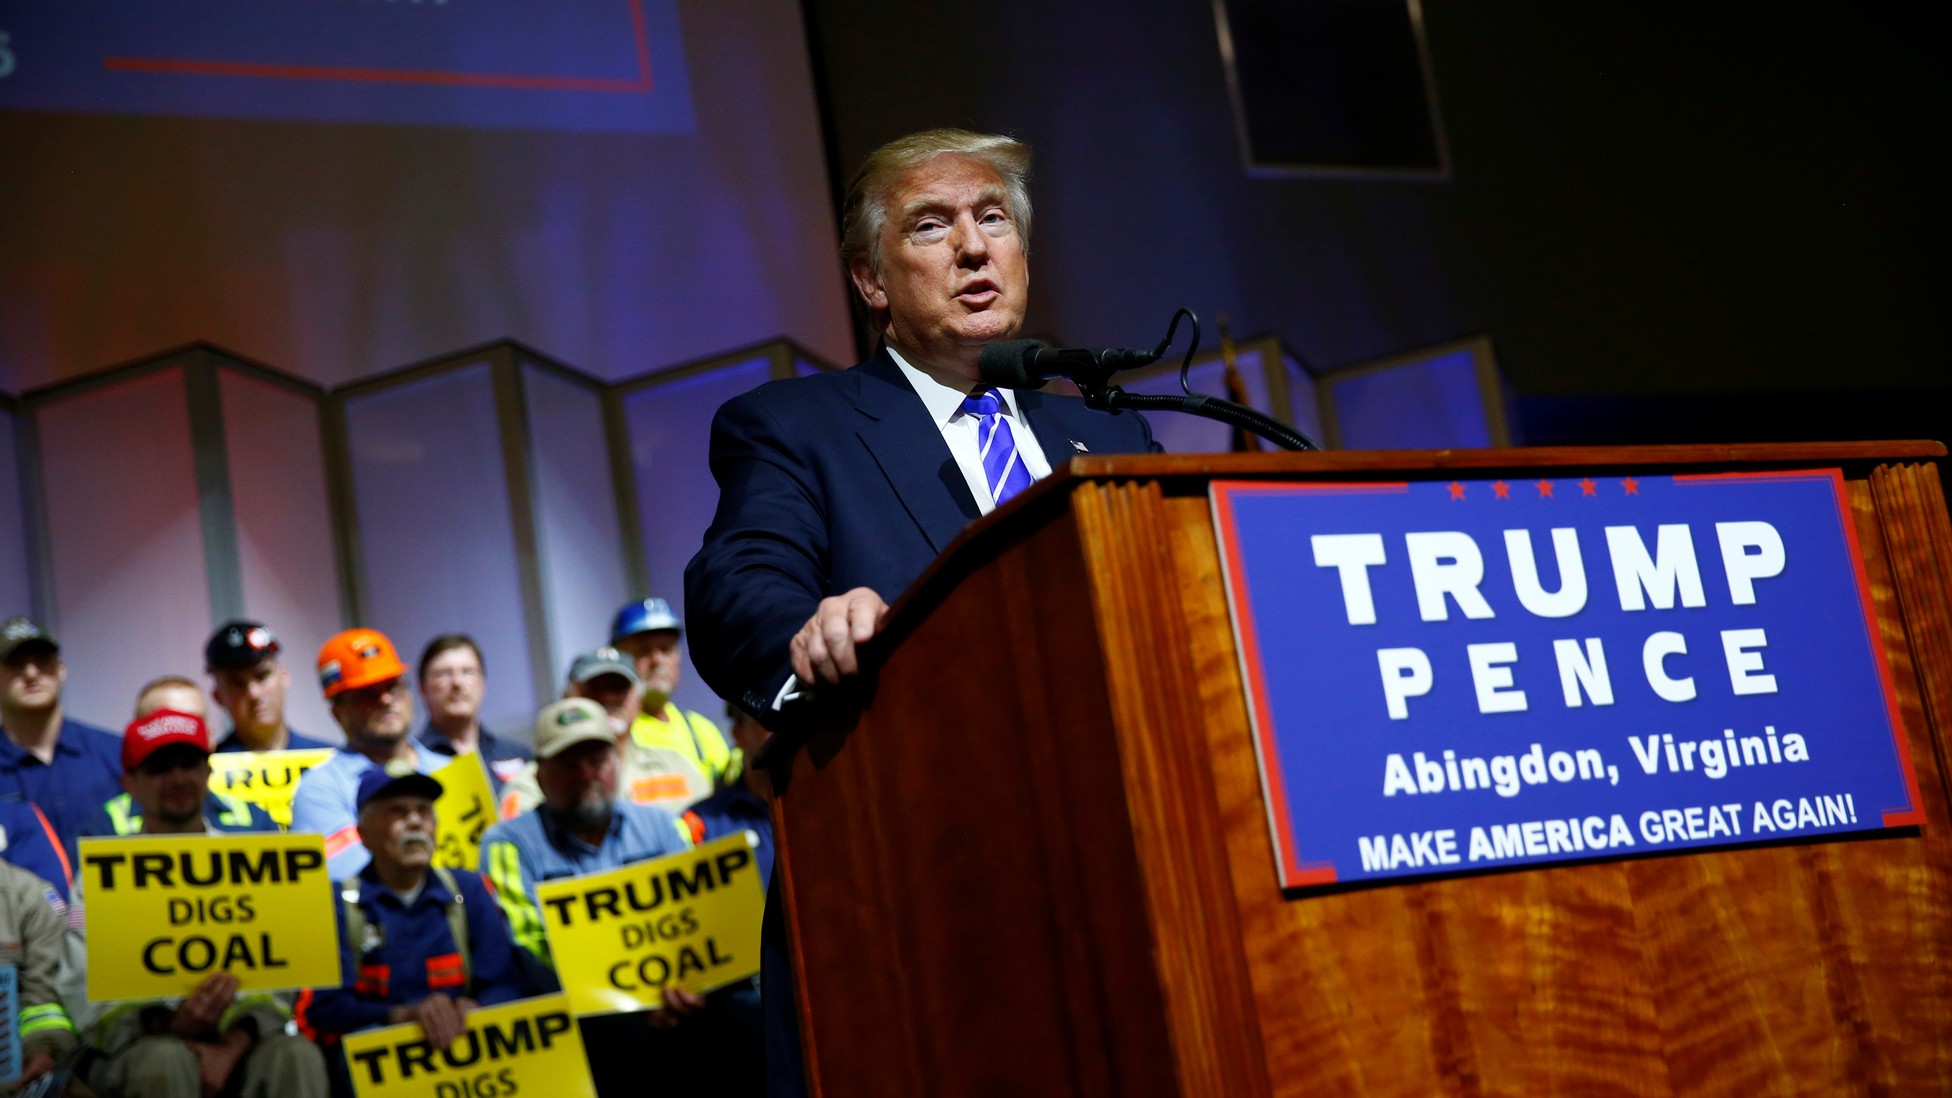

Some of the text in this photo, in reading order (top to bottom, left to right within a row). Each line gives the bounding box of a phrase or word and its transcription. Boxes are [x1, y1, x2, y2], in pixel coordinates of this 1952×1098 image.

[1310, 520, 1786, 626] TRUMP
[1376, 628, 1779, 720] PENCE
[1383, 725, 1810, 798] Abingdon, Virginia
[1358, 793, 1859, 872] MAKE AMERICA GREAT AGAIN!
[85, 848, 323, 892] TRUMP
[544, 847, 751, 927] TRUMP
[167, 895, 257, 928] DIGS
[619, 907, 699, 951] DIGS
[141, 933, 289, 976] COAL
[607, 936, 735, 992] COAL
[353, 1009, 573, 1086] TRUMP
